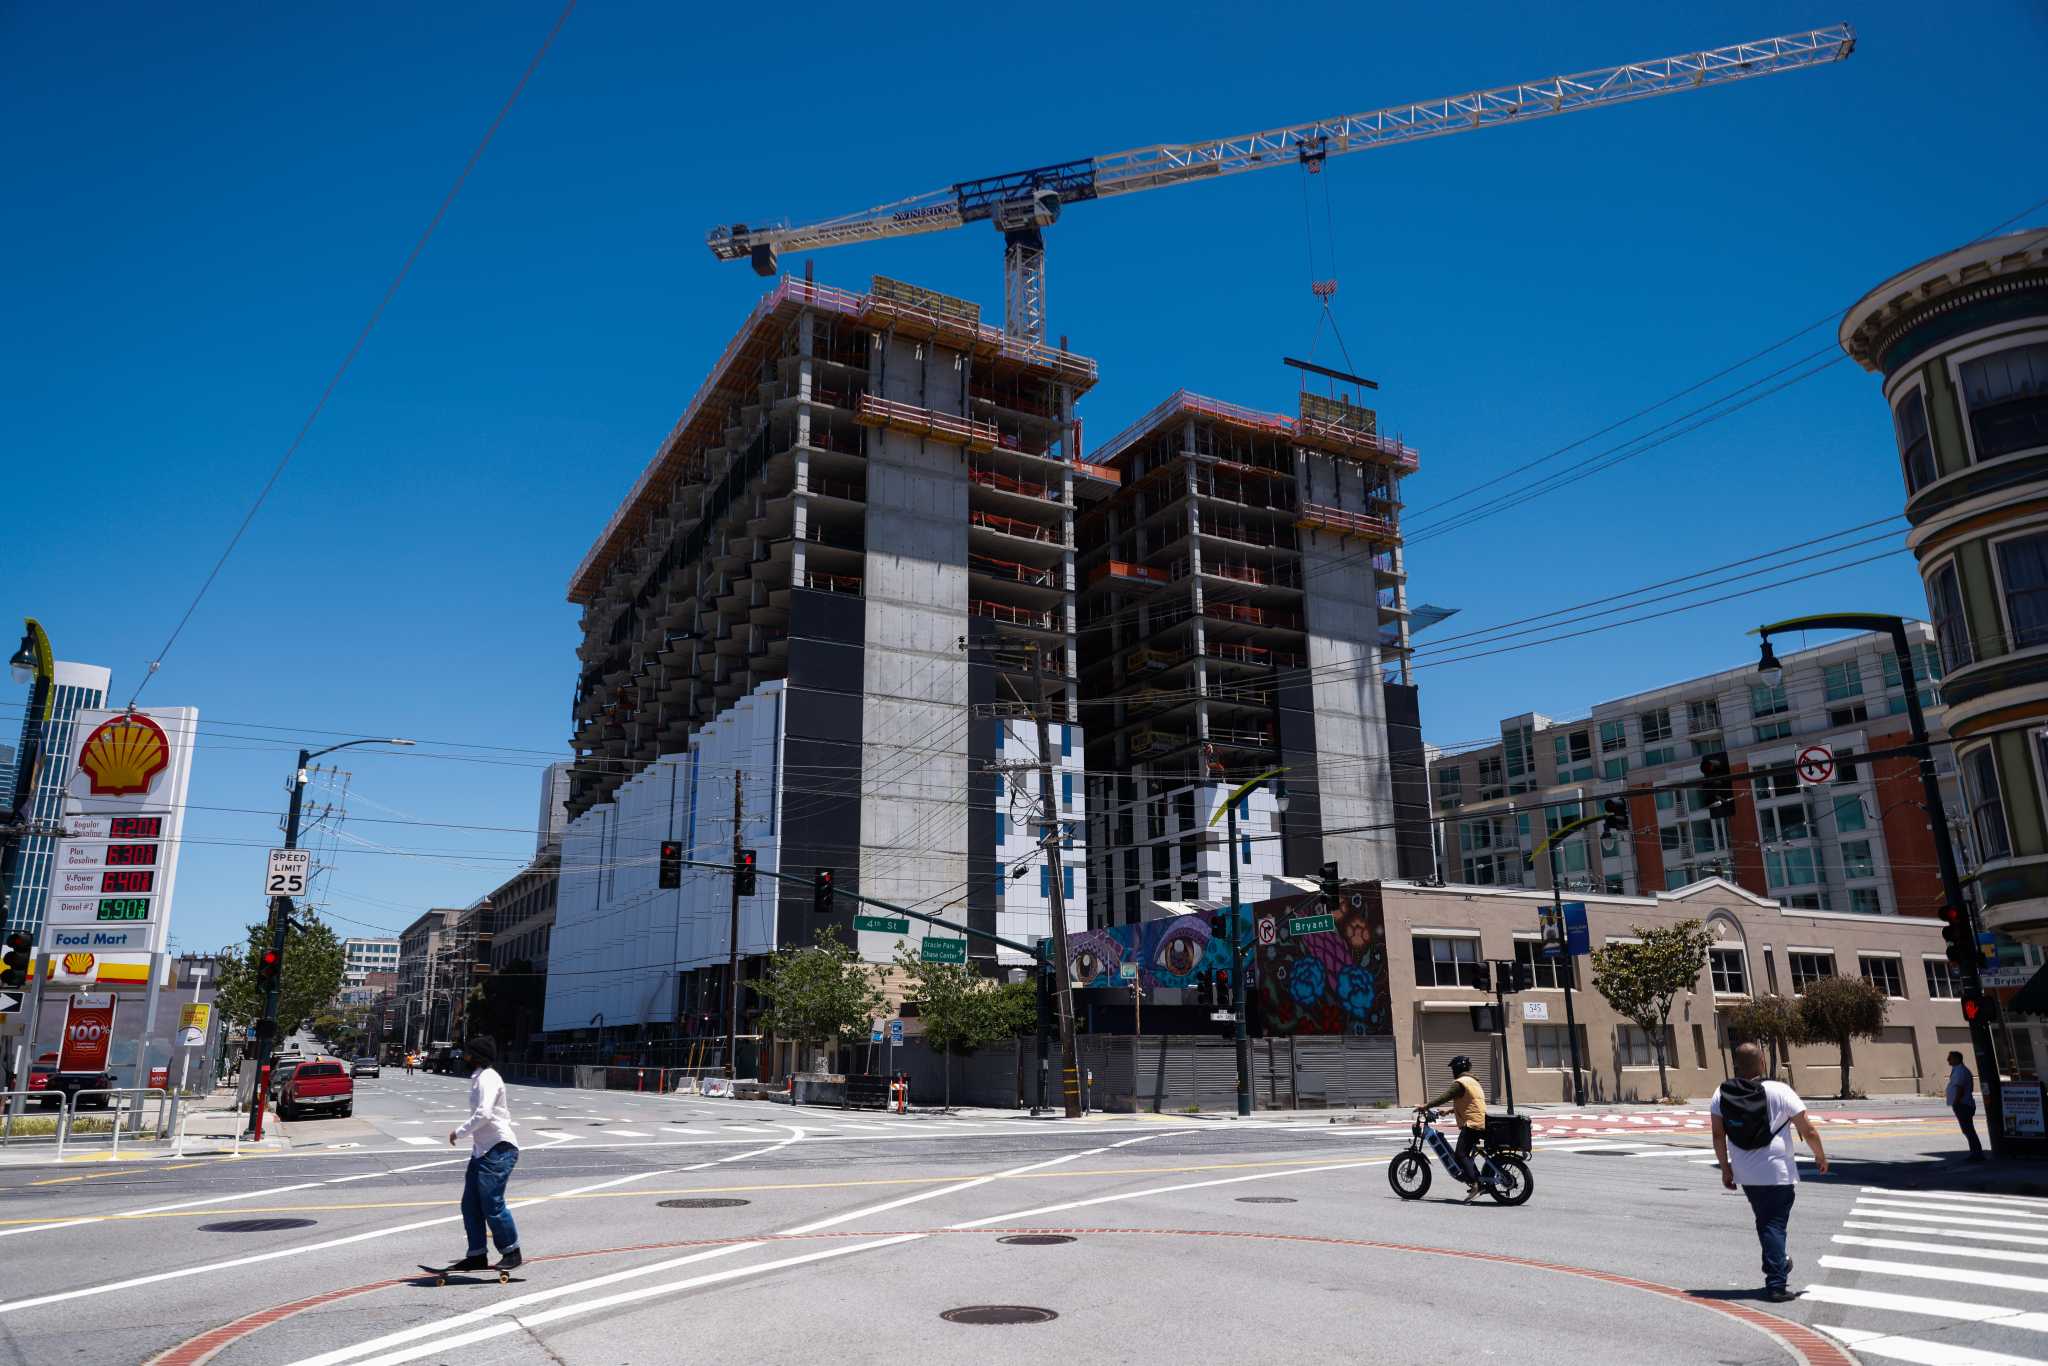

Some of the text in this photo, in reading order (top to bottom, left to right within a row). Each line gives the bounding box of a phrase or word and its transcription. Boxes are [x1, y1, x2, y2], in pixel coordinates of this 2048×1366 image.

[74, 820, 100, 830] Regular
[70, 848, 84, 856] Plus
[68, 856, 98, 865] Gasoline
[272, 853, 307, 862] SPEED
[274, 864, 302, 872] LIMIT
[66, 874, 94, 882] V-Power
[64, 883, 94, 892] Gasoline
[270, 875, 303, 891] 25
[61, 902, 82, 911] Diesel
[866, 919, 897, 930] 4th St
[1295, 918, 1329, 932] Bryant
[55, 933, 128, 945] Food Mart
[939, 951, 957, 959] Center
[1994, 977, 2026, 987] Bryant
[69, 1024, 112, 1041] 100%
